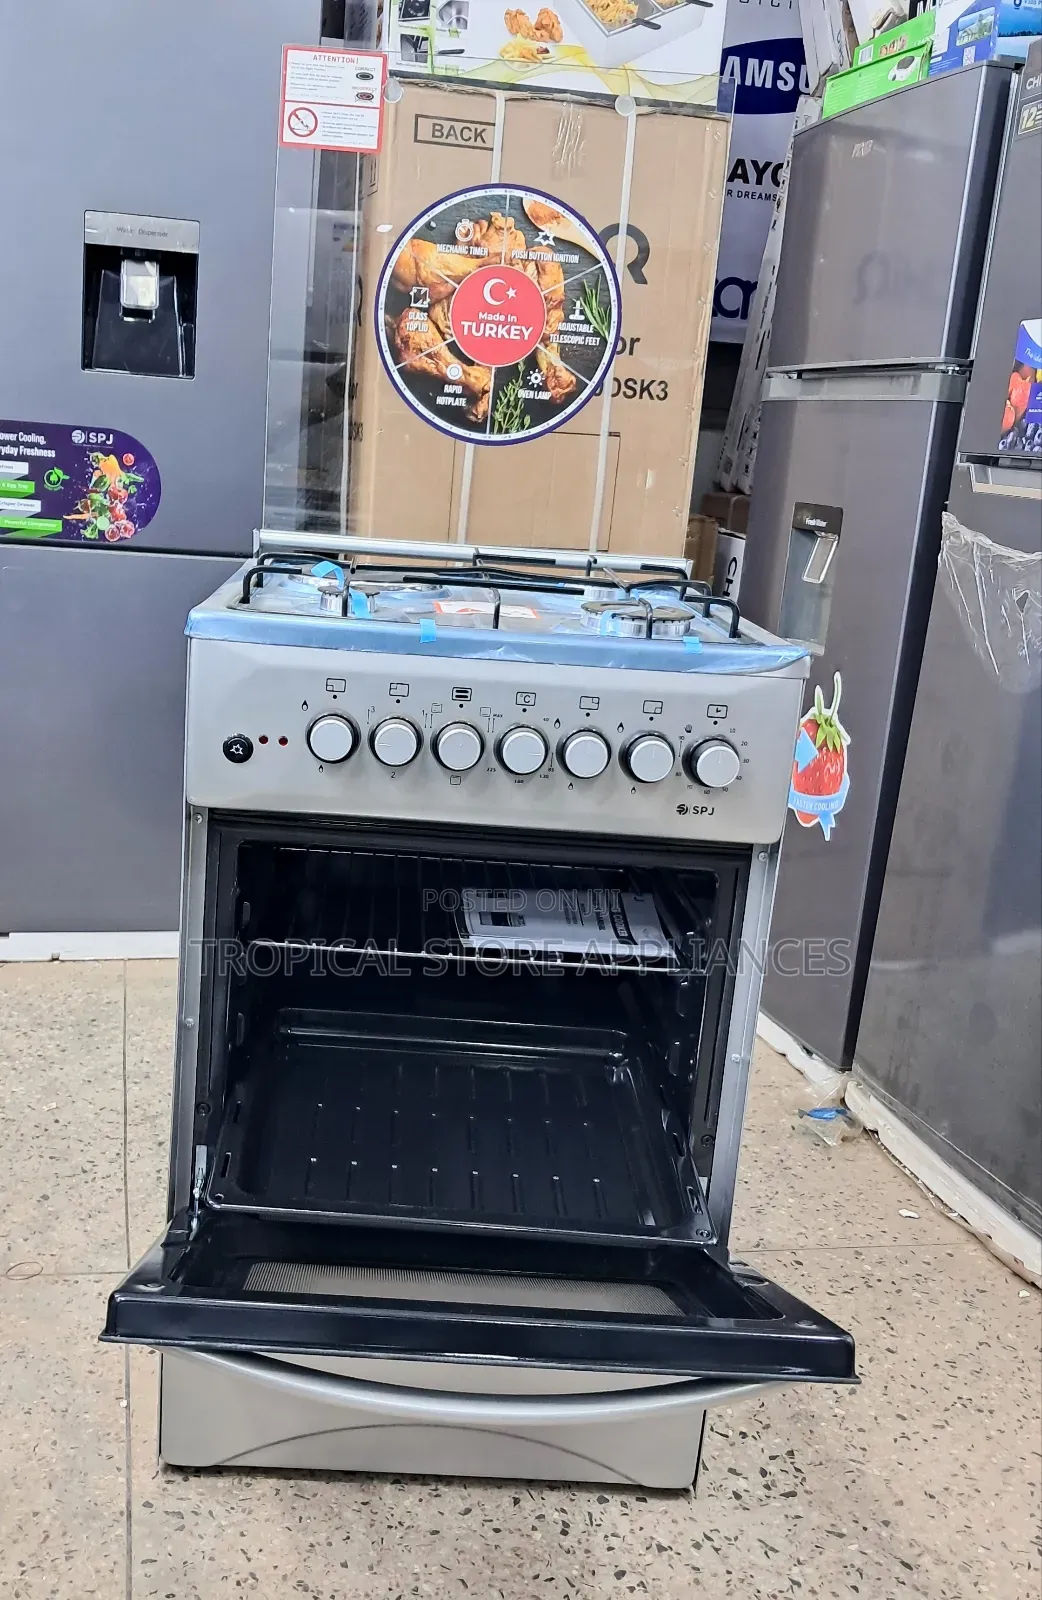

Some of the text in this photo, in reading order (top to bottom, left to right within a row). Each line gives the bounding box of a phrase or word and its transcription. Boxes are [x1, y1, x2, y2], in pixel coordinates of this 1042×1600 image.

[312, 54, 359, 64] ATTENTION!
[431, 122, 488, 144] BACK
[138, 228, 169, 238] Dispenser
[436, 243, 488, 257] MECHANIC TIMER
[511, 249, 580, 264] PUSH BUTTON IGNITION
[408, 311, 428, 321] GLASS
[478, 311, 505, 322] Made
[405, 321, 417, 332] TOP
[460, 321, 534, 341] TURKEY
[557, 321, 595, 333] ADJUSTABLE
[549, 333, 601, 346] TELESCOPIC FEET
[443, 384, 462, 394] RAPID
[517, 388, 552, 400] OVEN LAMP
[435, 395, 467, 407] HOTPLATE
[18, 431, 47, 445] Cooling,
[89, 431, 114, 445] SPJ
[19, 445, 56, 458] Freshness
[390, 771, 396, 779] 2
[692, 805, 715, 816] SPJ
